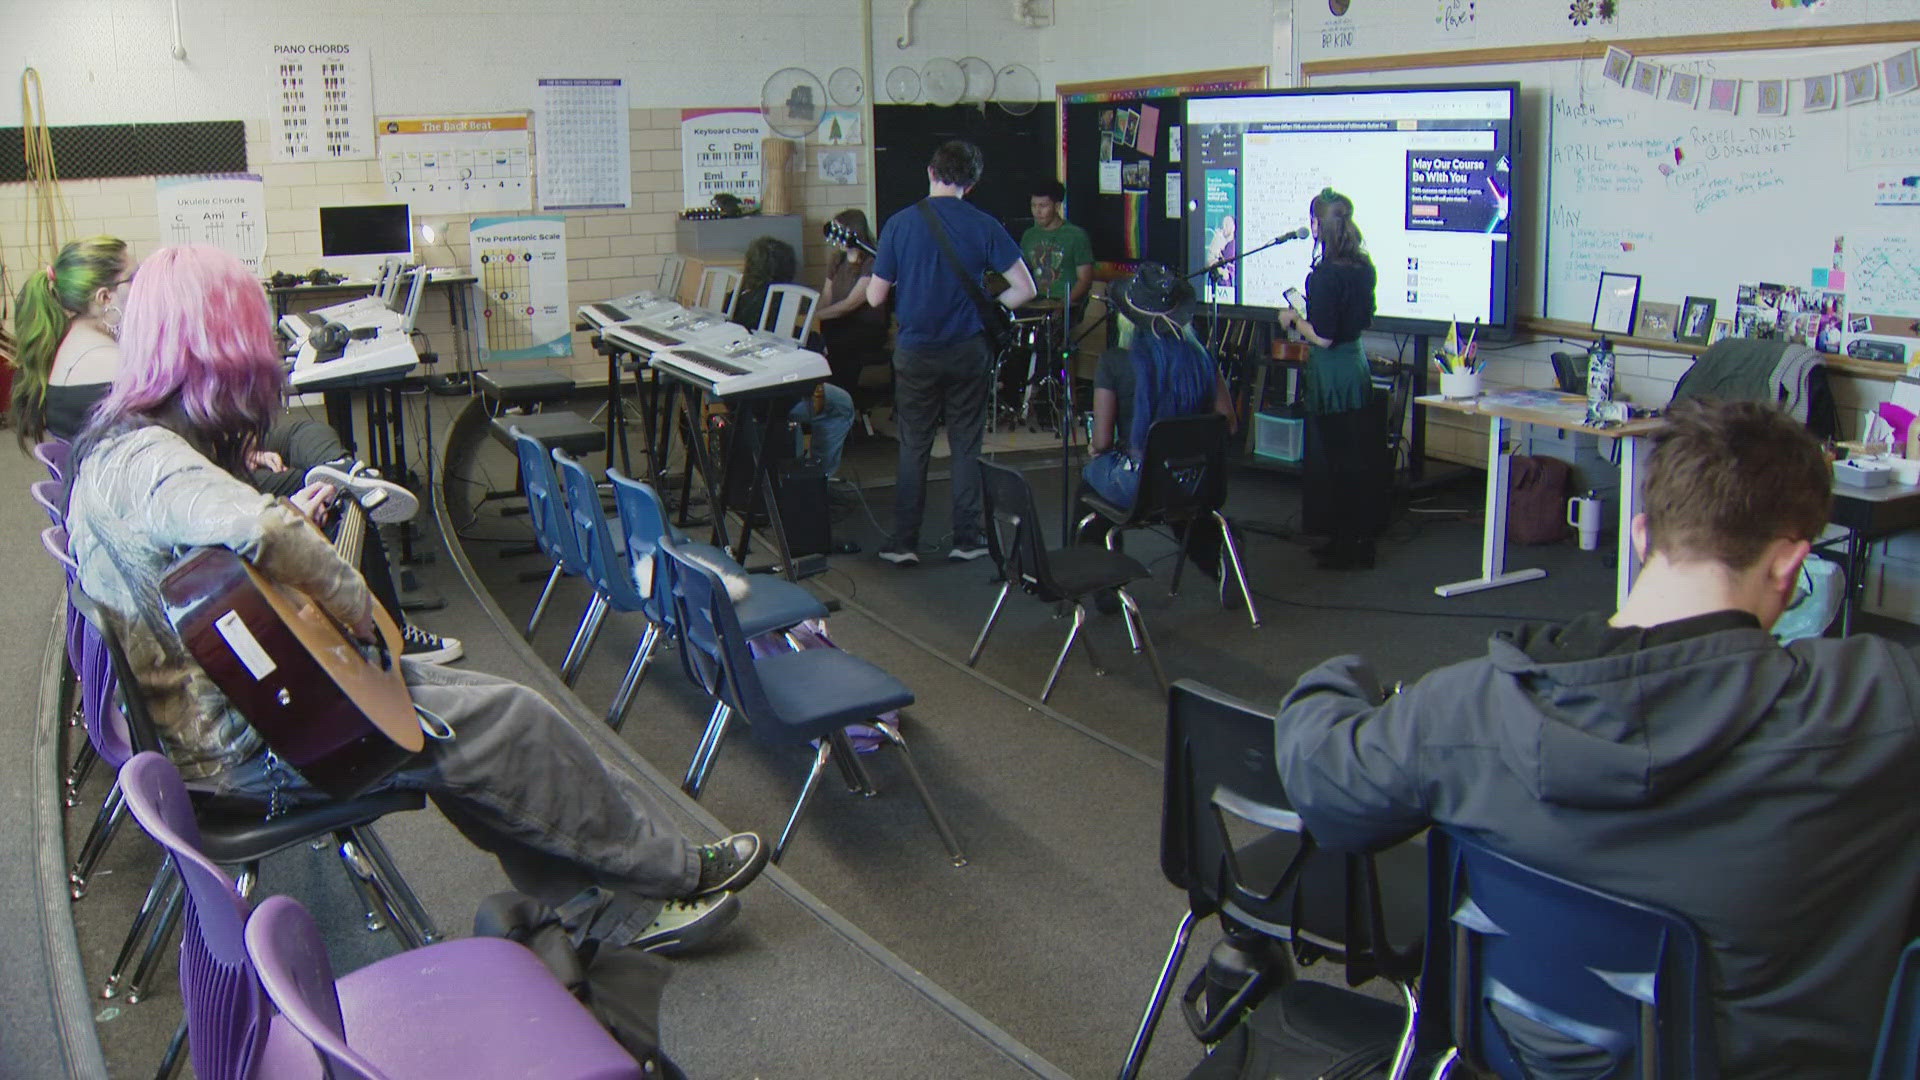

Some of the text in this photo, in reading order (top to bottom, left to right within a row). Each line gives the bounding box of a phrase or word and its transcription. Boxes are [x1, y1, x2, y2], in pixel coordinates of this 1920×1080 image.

[1334, 32, 1353, 48] KIND
[274, 44, 350, 54] PIANO CHORDS
[1555, 98, 1596, 119] MARCH
[422, 120, 492, 132] The Back Beat
[694, 127, 760, 136] Keyboard Chords
[708, 142, 754, 152] C Dmi
[1554, 144, 1603, 163] APRIL
[1412, 158, 1484, 170] May Our Course
[704, 170, 748, 180] Emi F
[1412, 171, 1467, 183] Be With You
[429, 184, 434, 192] 2
[464, 182, 470, 190] 3
[177, 196, 245, 206] Ukulele Chords
[175, 211, 248, 222] C Ami F
[1552, 203, 1581, 229] MAY
[493, 233, 537, 243] Pentatonic
[539, 233, 560, 241] Scale
